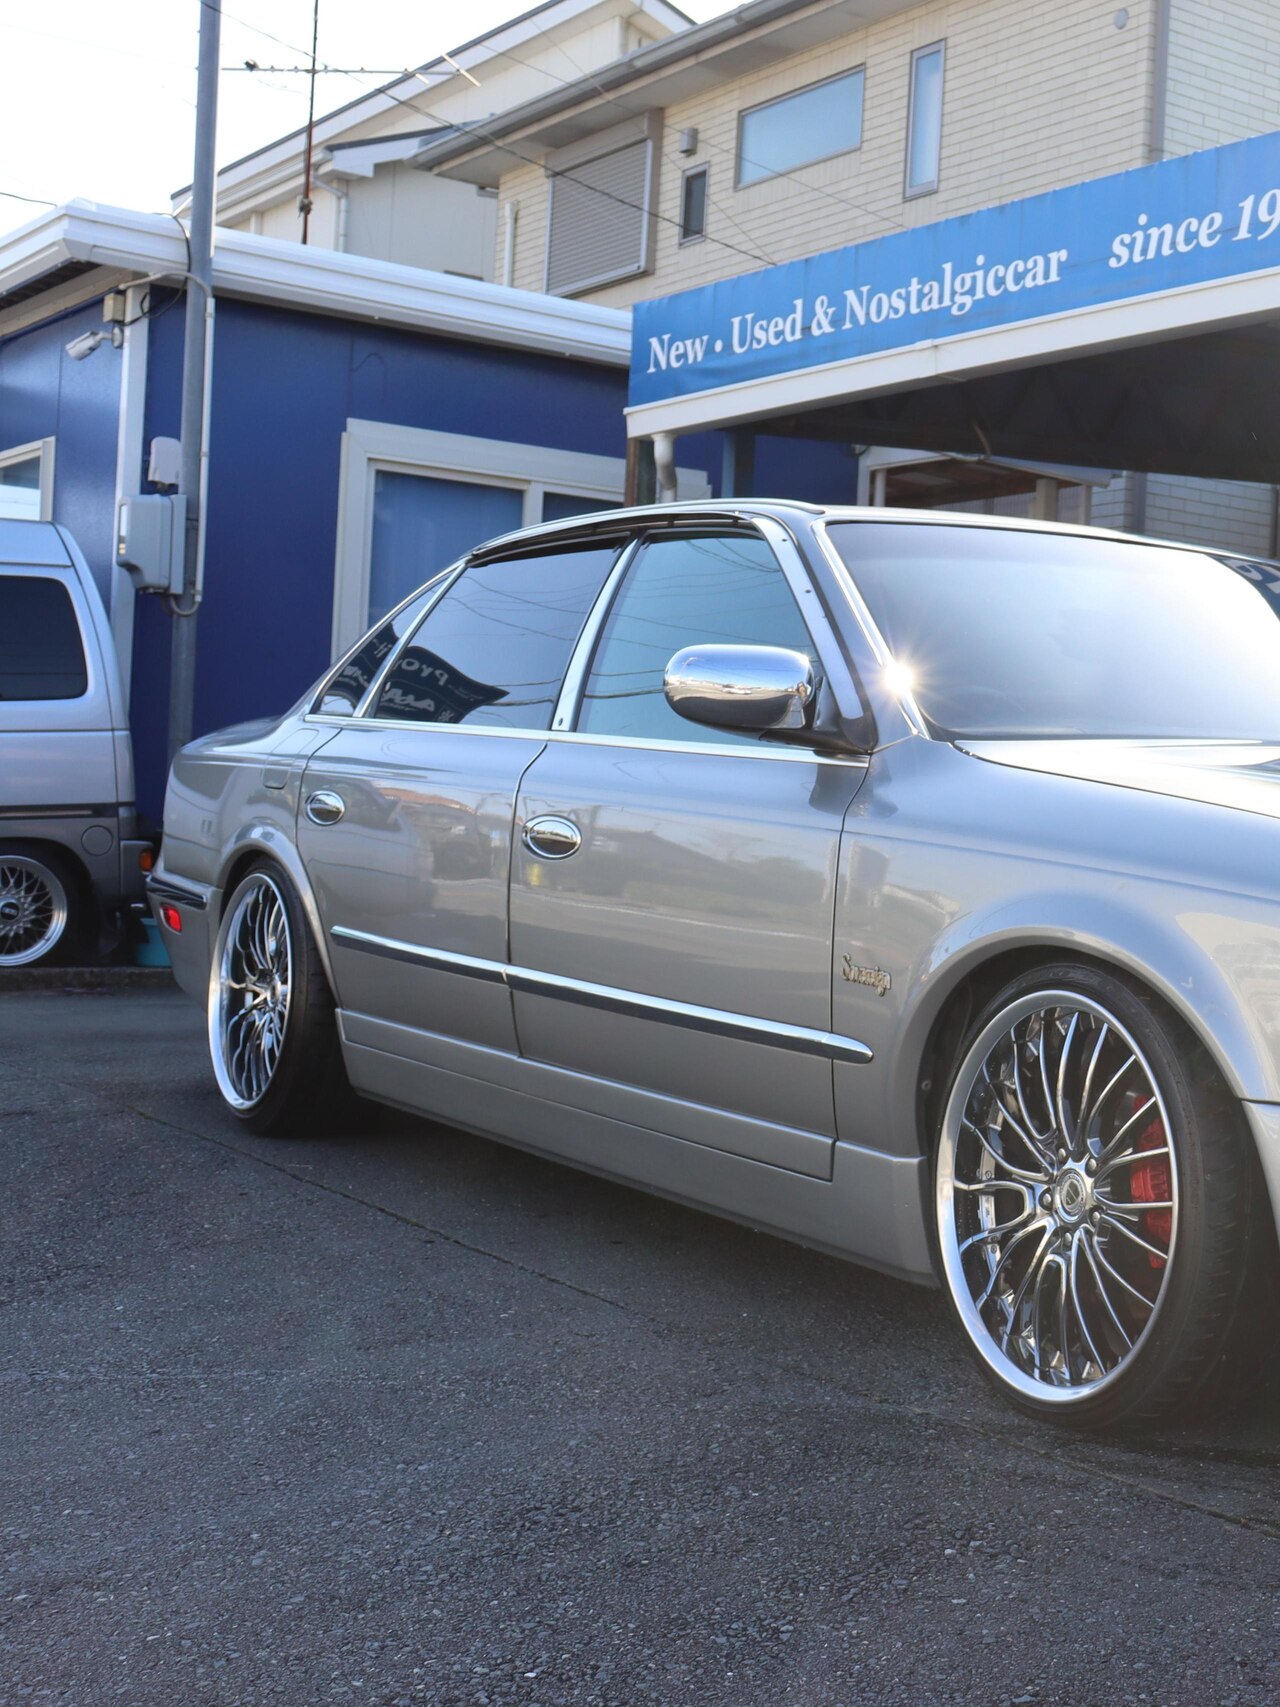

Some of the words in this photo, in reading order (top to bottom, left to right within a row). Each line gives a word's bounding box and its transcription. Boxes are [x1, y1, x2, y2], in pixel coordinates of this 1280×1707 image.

[646, 333, 709, 374] New
[730, 298, 803, 354] Used
[810, 295, 836, 337] &
[841, 248, 1069, 316] Nostalgiccar
[1107, 213, 1223, 269] since
